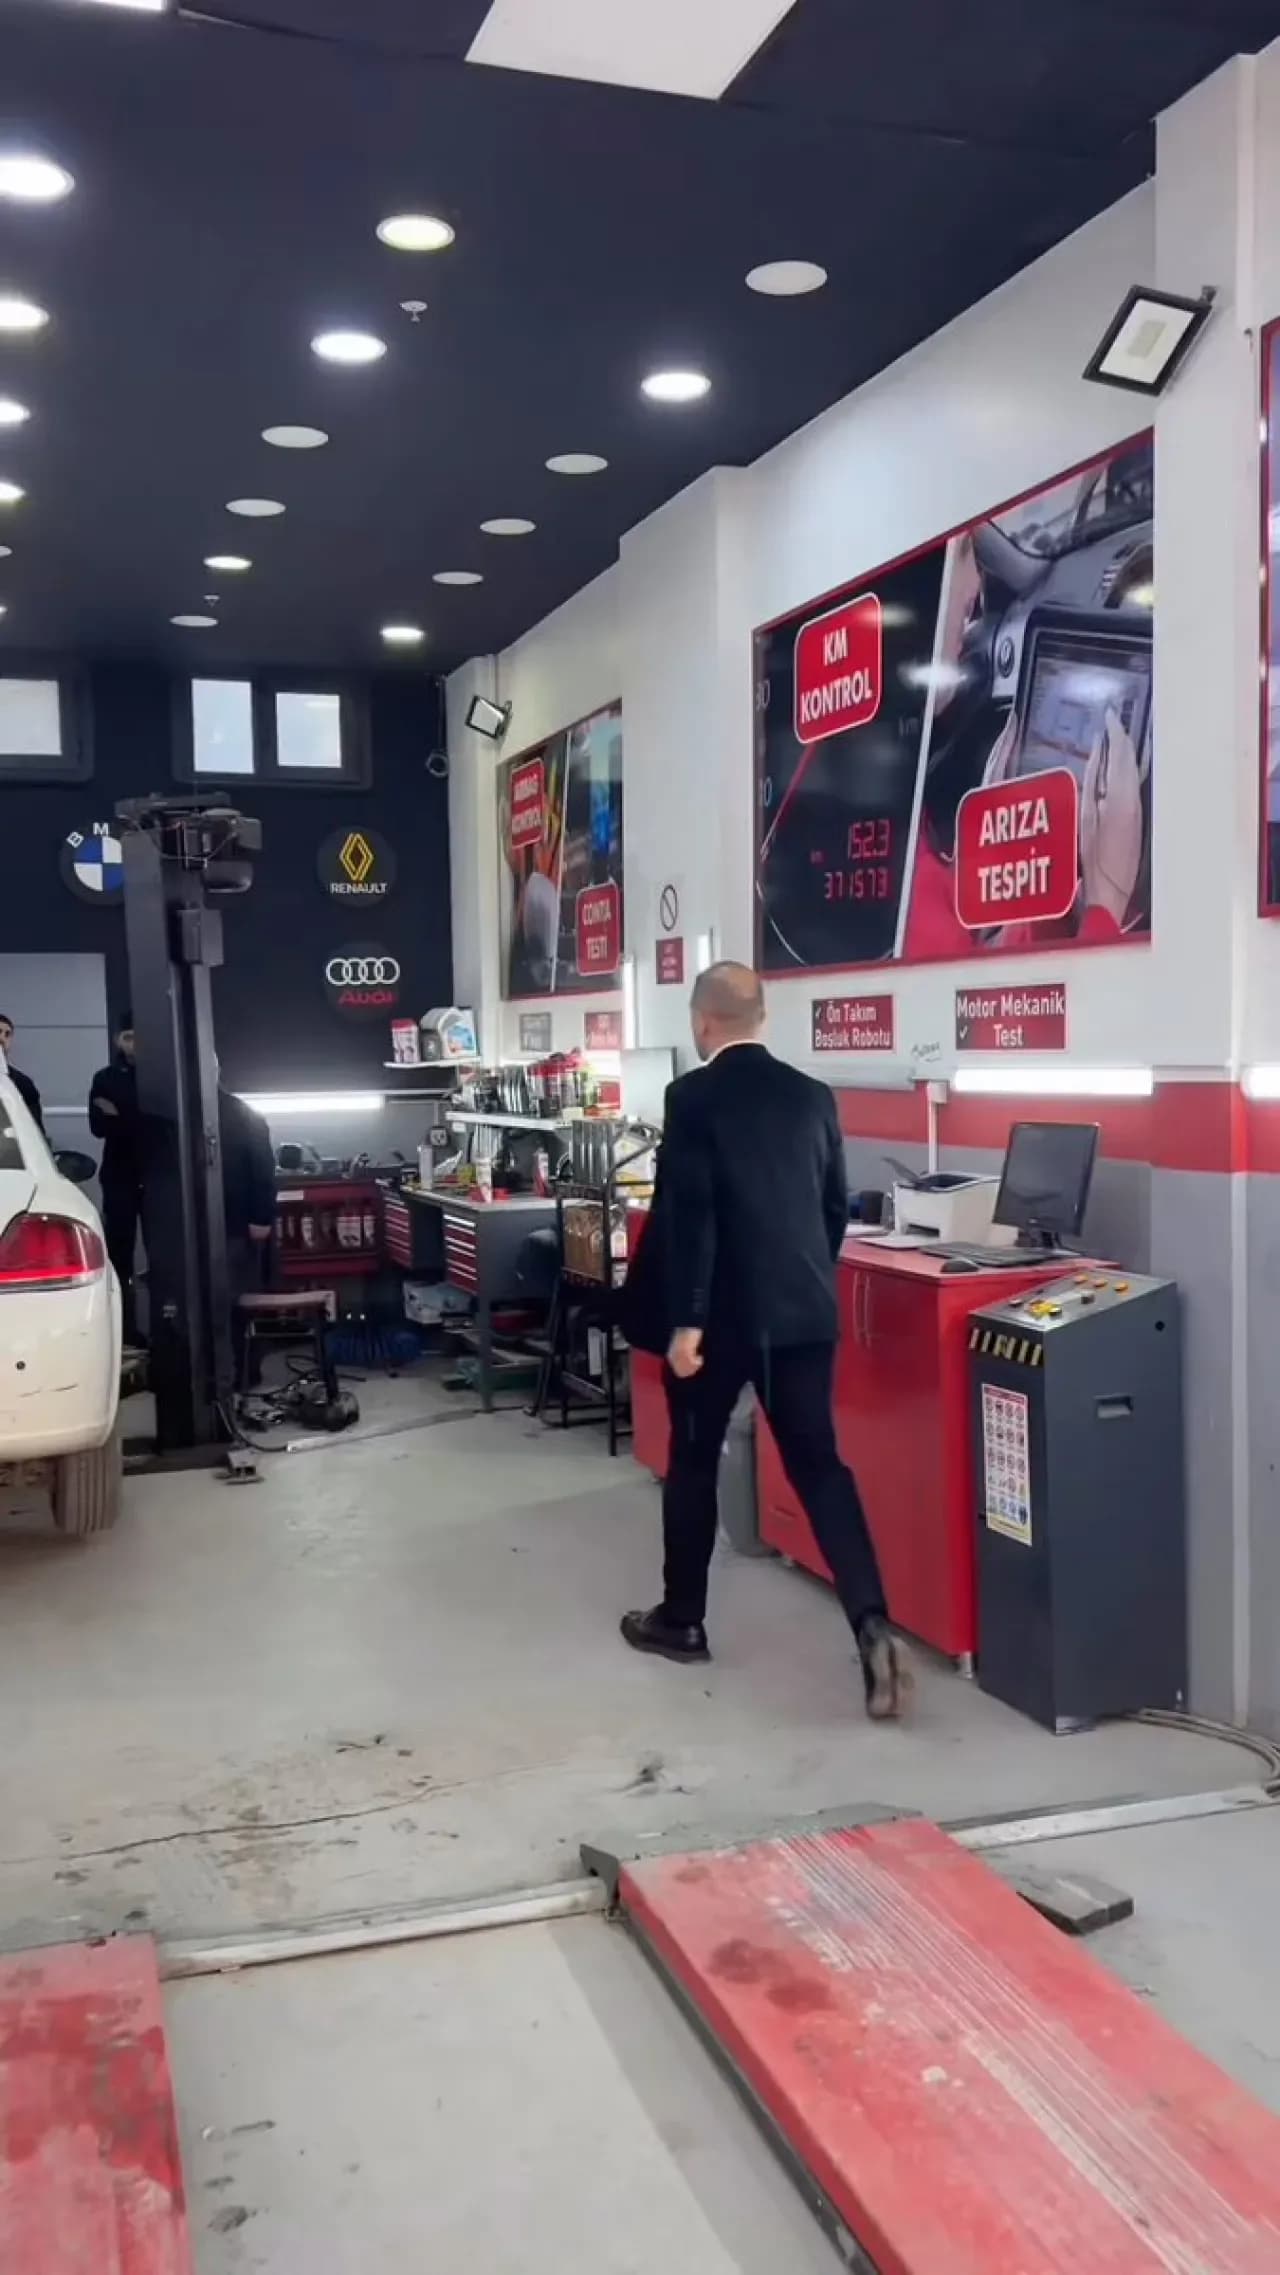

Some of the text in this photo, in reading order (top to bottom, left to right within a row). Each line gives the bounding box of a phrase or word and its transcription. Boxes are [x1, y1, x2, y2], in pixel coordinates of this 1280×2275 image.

[823, 626, 848, 666] KM
[801, 667, 872, 724] KONTROL
[66, 822, 109, 848] BM
[979, 797, 1049, 848] ARIZA
[330, 882, 387, 894] RENAULT
[977, 846, 1051, 903] TESPİT
[826, 1001, 841, 1023] Ön
[957, 991, 1065, 1019] Motor Mekanik
[852, 1027, 891, 1047] Robotu
[993, 1023, 1024, 1048] Test
